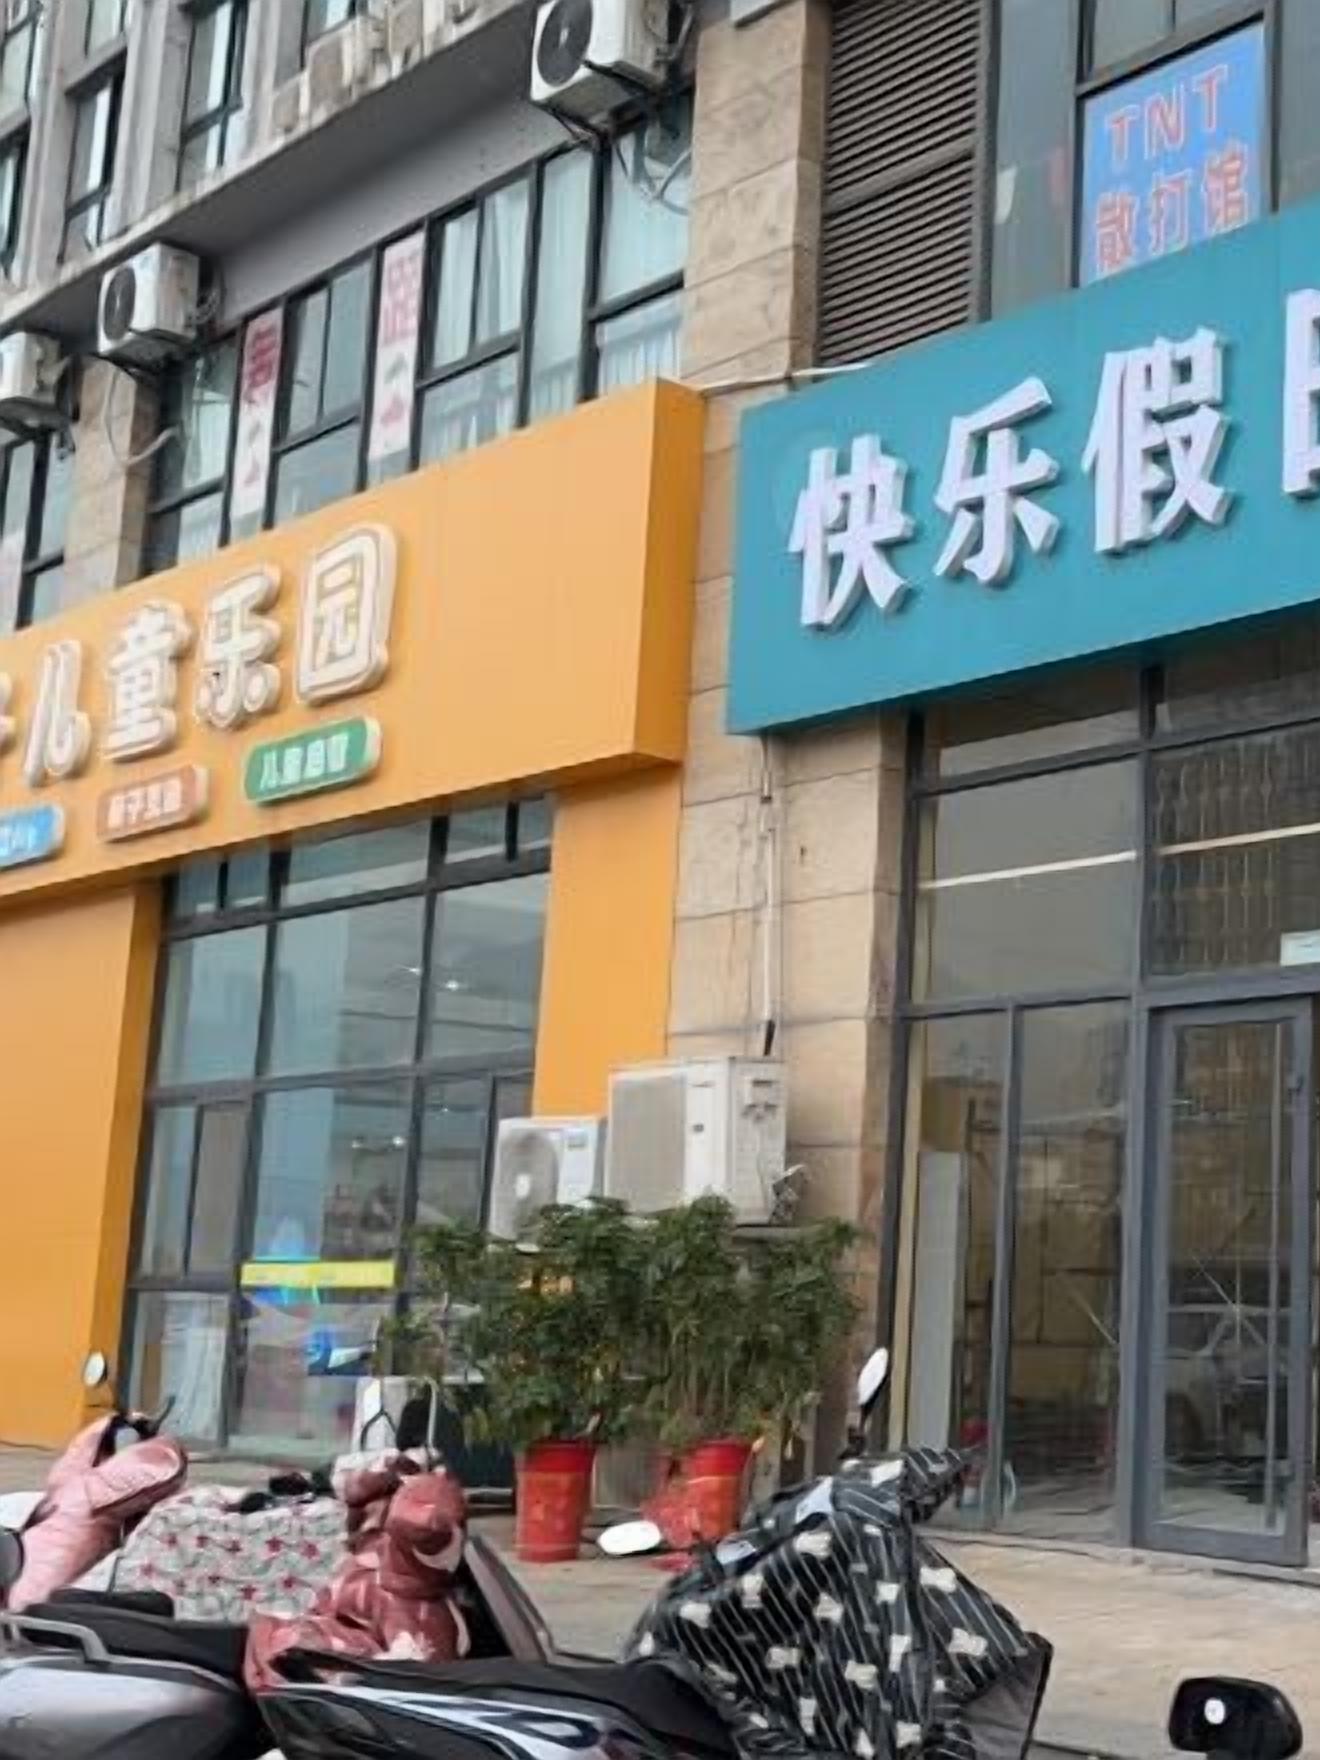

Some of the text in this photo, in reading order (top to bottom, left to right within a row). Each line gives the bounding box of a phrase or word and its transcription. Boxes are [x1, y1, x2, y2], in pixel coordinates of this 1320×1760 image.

[1105, 64, 1229, 174] TNT
[0, 522, 399, 789] 儿童乐园
